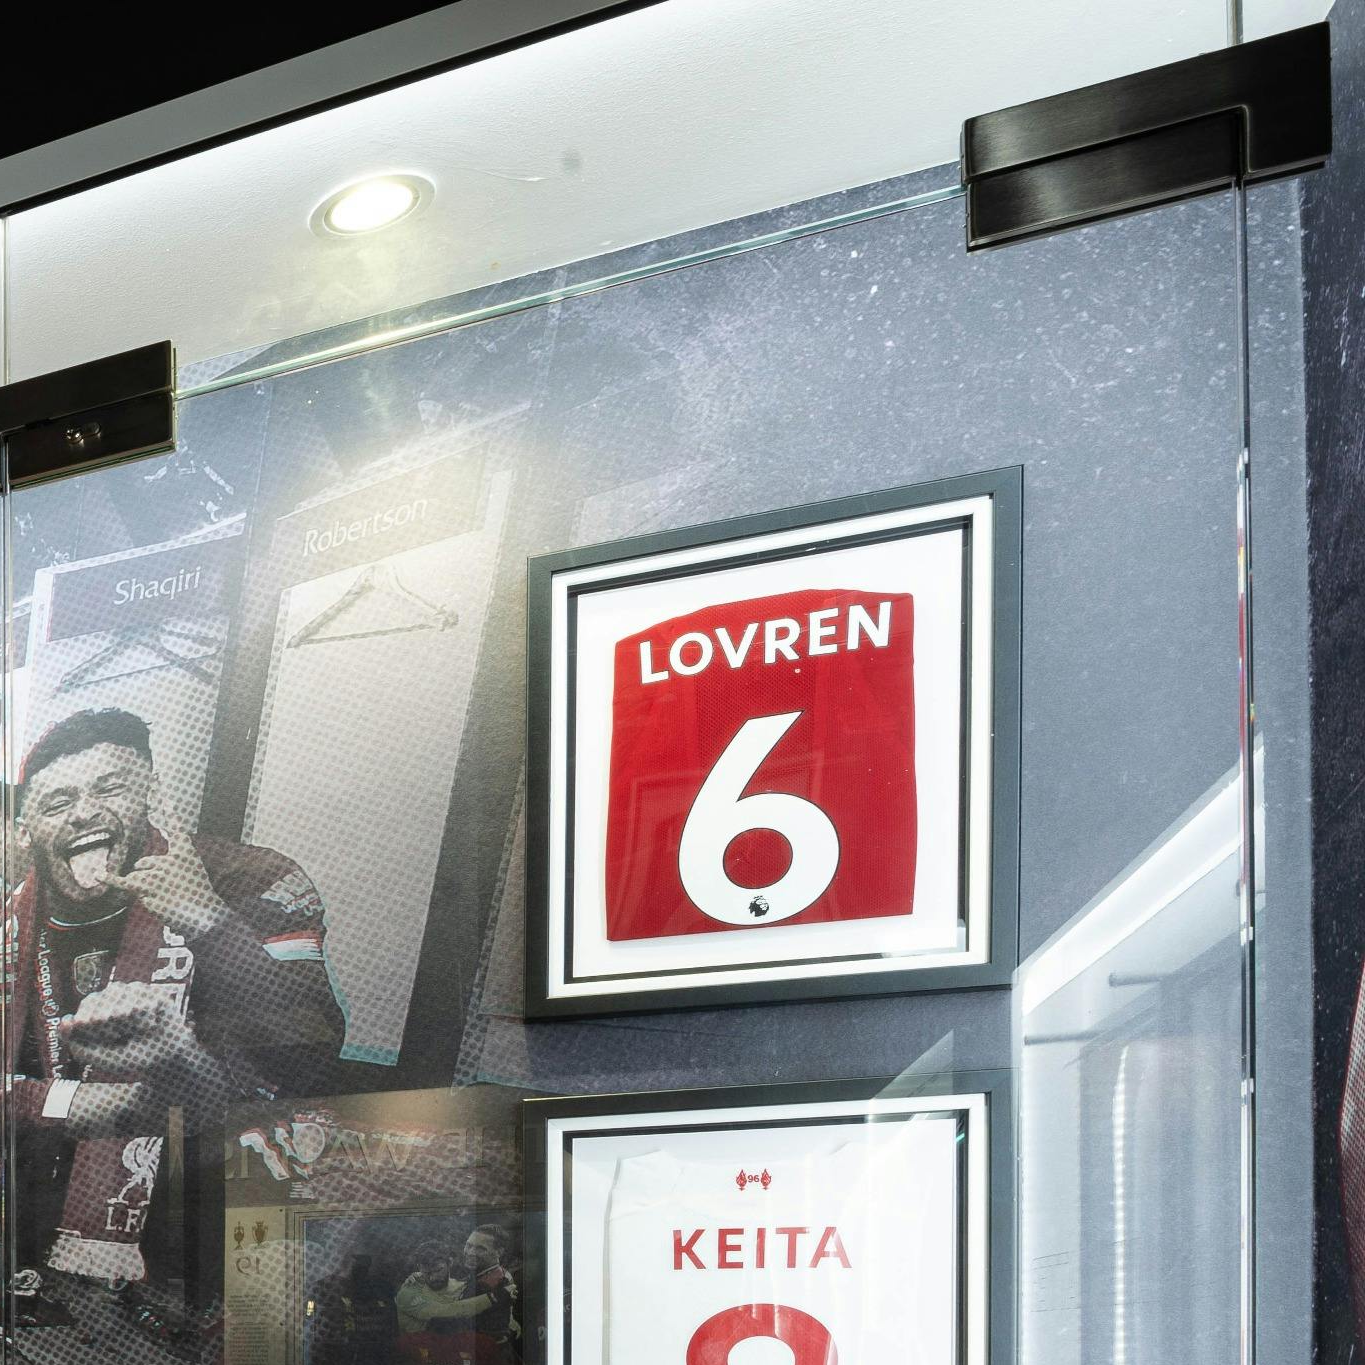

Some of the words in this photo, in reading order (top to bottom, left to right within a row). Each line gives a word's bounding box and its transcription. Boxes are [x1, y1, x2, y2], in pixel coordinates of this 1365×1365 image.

[303, 499, 428, 558] Robertson
[113, 565, 201, 606] Shaqiri
[638, 601, 893, 685] LOVREN
[678, 709, 841, 927] 6
[747, 1175, 760, 1183] 96
[671, 1226, 852, 1271] KEITA
